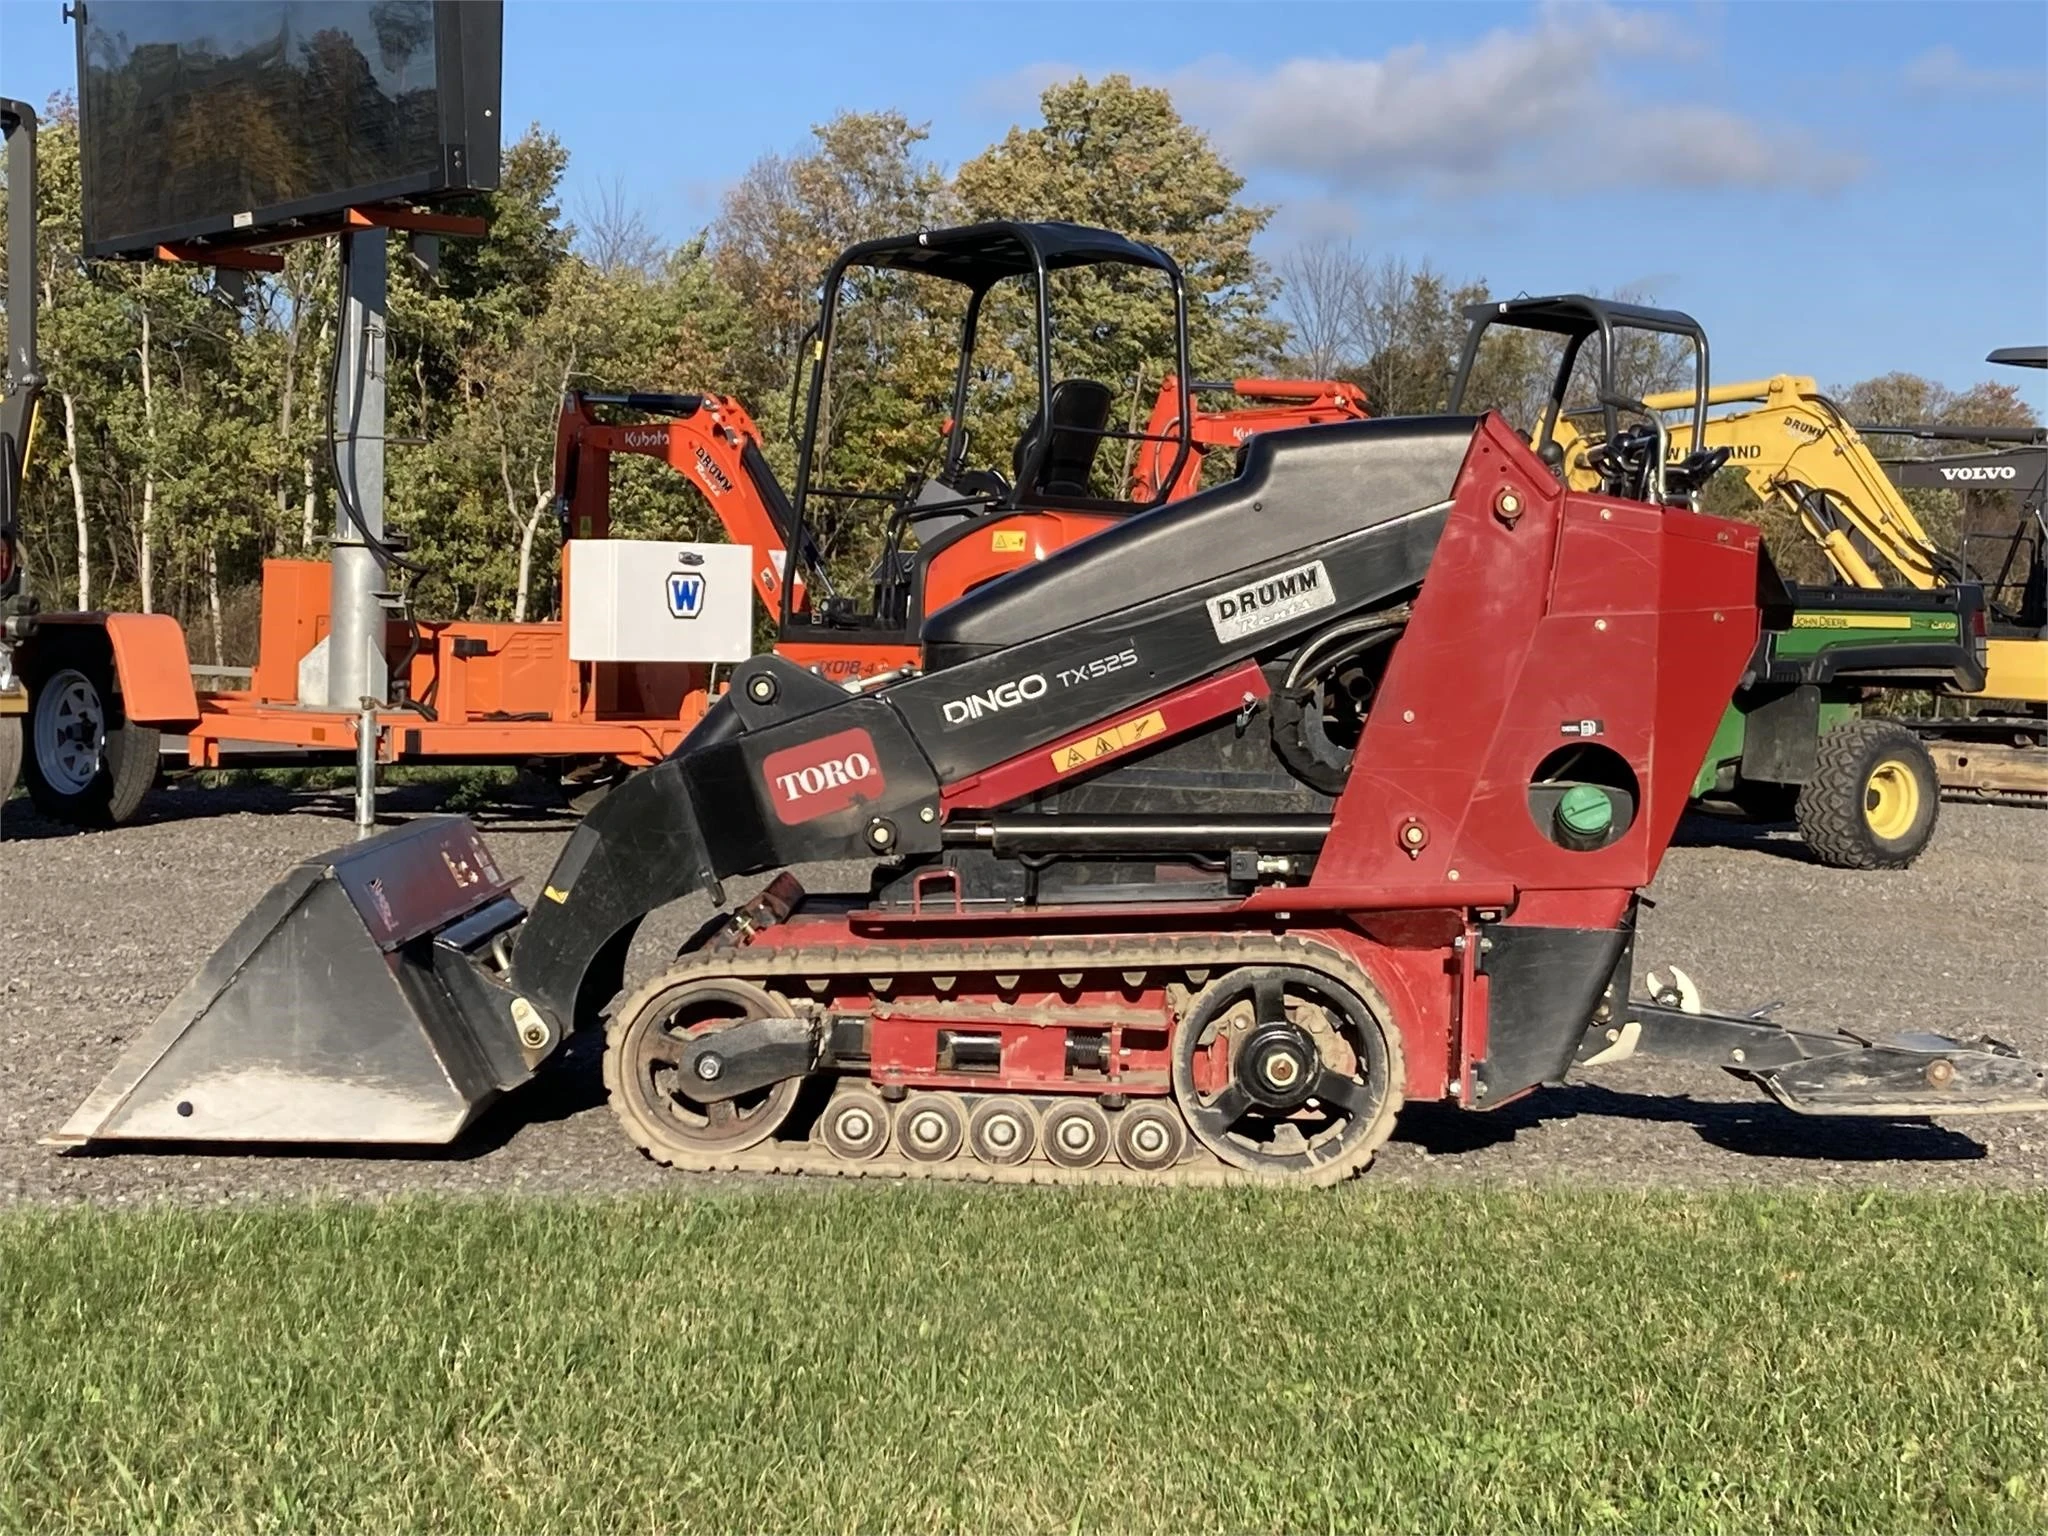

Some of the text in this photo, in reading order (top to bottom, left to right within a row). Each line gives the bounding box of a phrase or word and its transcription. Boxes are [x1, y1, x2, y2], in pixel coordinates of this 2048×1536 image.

[624, 430, 670, 447] Kubota
[695, 446, 733, 493] DRUMM
[1940, 466, 2016, 481] VOLVO
[671, 580, 700, 611] W
[1217, 565, 1319, 621] DRUMM
[1794, 615, 1819, 627] JOHN
[942, 673, 1048, 724] DINGO
[776, 752, 871, 801] TORO
